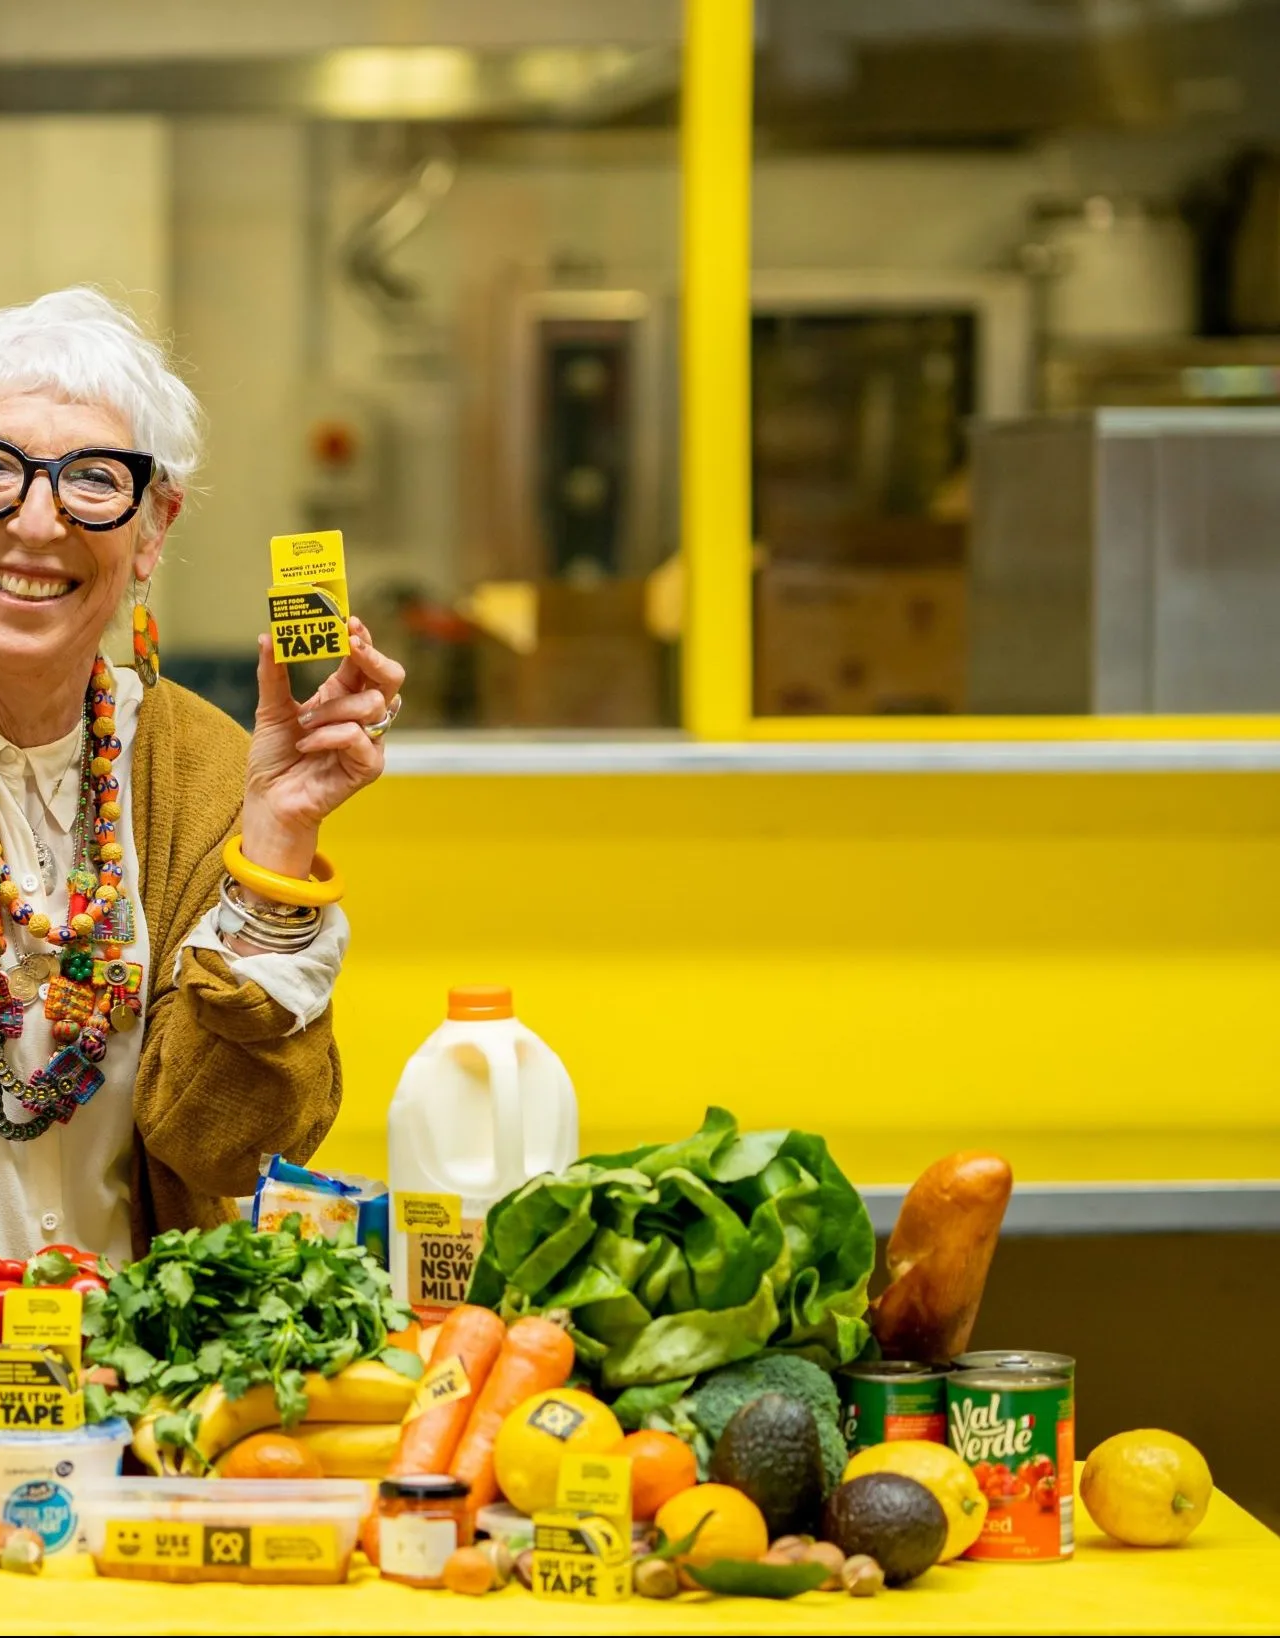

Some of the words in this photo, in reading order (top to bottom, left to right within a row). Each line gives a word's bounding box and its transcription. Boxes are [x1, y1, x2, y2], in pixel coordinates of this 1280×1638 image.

[280, 565, 304, 573] MAKING
[288, 597, 305, 605] FOOD
[301, 608, 323, 616] PLANET
[276, 624, 302, 637] USE
[303, 622, 315, 634] IT
[318, 621, 336, 633] UP
[276, 632, 341, 658] TAPE
[420, 1241, 474, 1261] 100%
[421, 1260, 473, 1281] NSW
[0, 1391, 24, 1403] USE
[27, 1391, 40, 1403] IT
[43, 1391, 62, 1403] UP
[432, 1379, 458, 1399] ME
[0, 1404, 64, 1425] TAPE
[951, 1393, 1003, 1440] Val
[950, 1418, 1033, 1462] Verde
[155, 1533, 190, 1548] USE
[538, 1571, 598, 1597] TAPE
